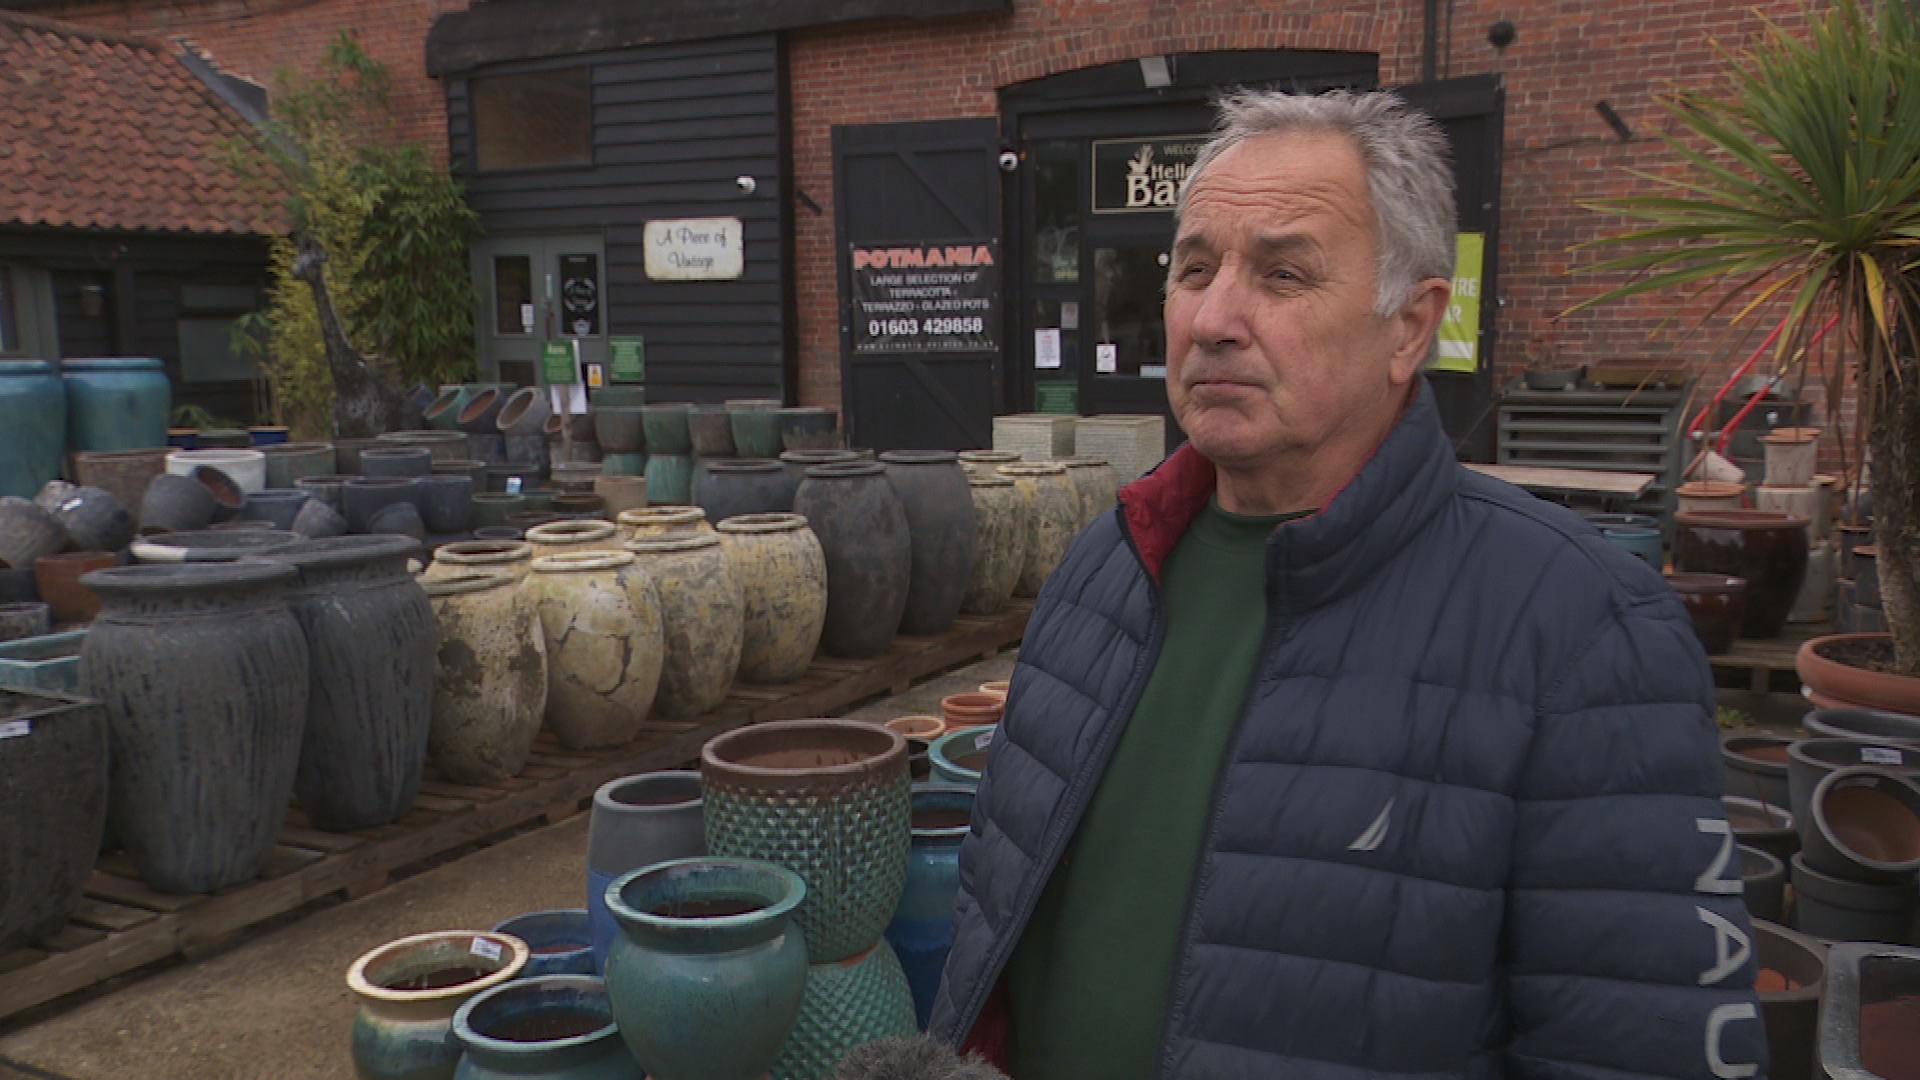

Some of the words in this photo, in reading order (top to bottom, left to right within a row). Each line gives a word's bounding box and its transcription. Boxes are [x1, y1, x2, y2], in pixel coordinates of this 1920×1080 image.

[1163, 144, 1200, 156] WELCO
[656, 228, 673, 247] A
[713, 226, 727, 248] of
[853, 246, 993, 269] POTMANIA
[871, 275, 903, 286] LARGE
[906, 273, 961, 285] SELECTION
[964, 272, 978, 283] OF
[1450, 278, 1478, 297] TRE
[889, 287, 952, 299] TERRACOTTA
[921, 299, 962, 312] GLAZED
[962, 298, 989, 310] POTS
[1443, 304, 1462, 323] AR
[869, 320, 918, 335] 01603
[923, 318, 983, 333] 429858
[1693, 817, 1759, 1079] NAU
